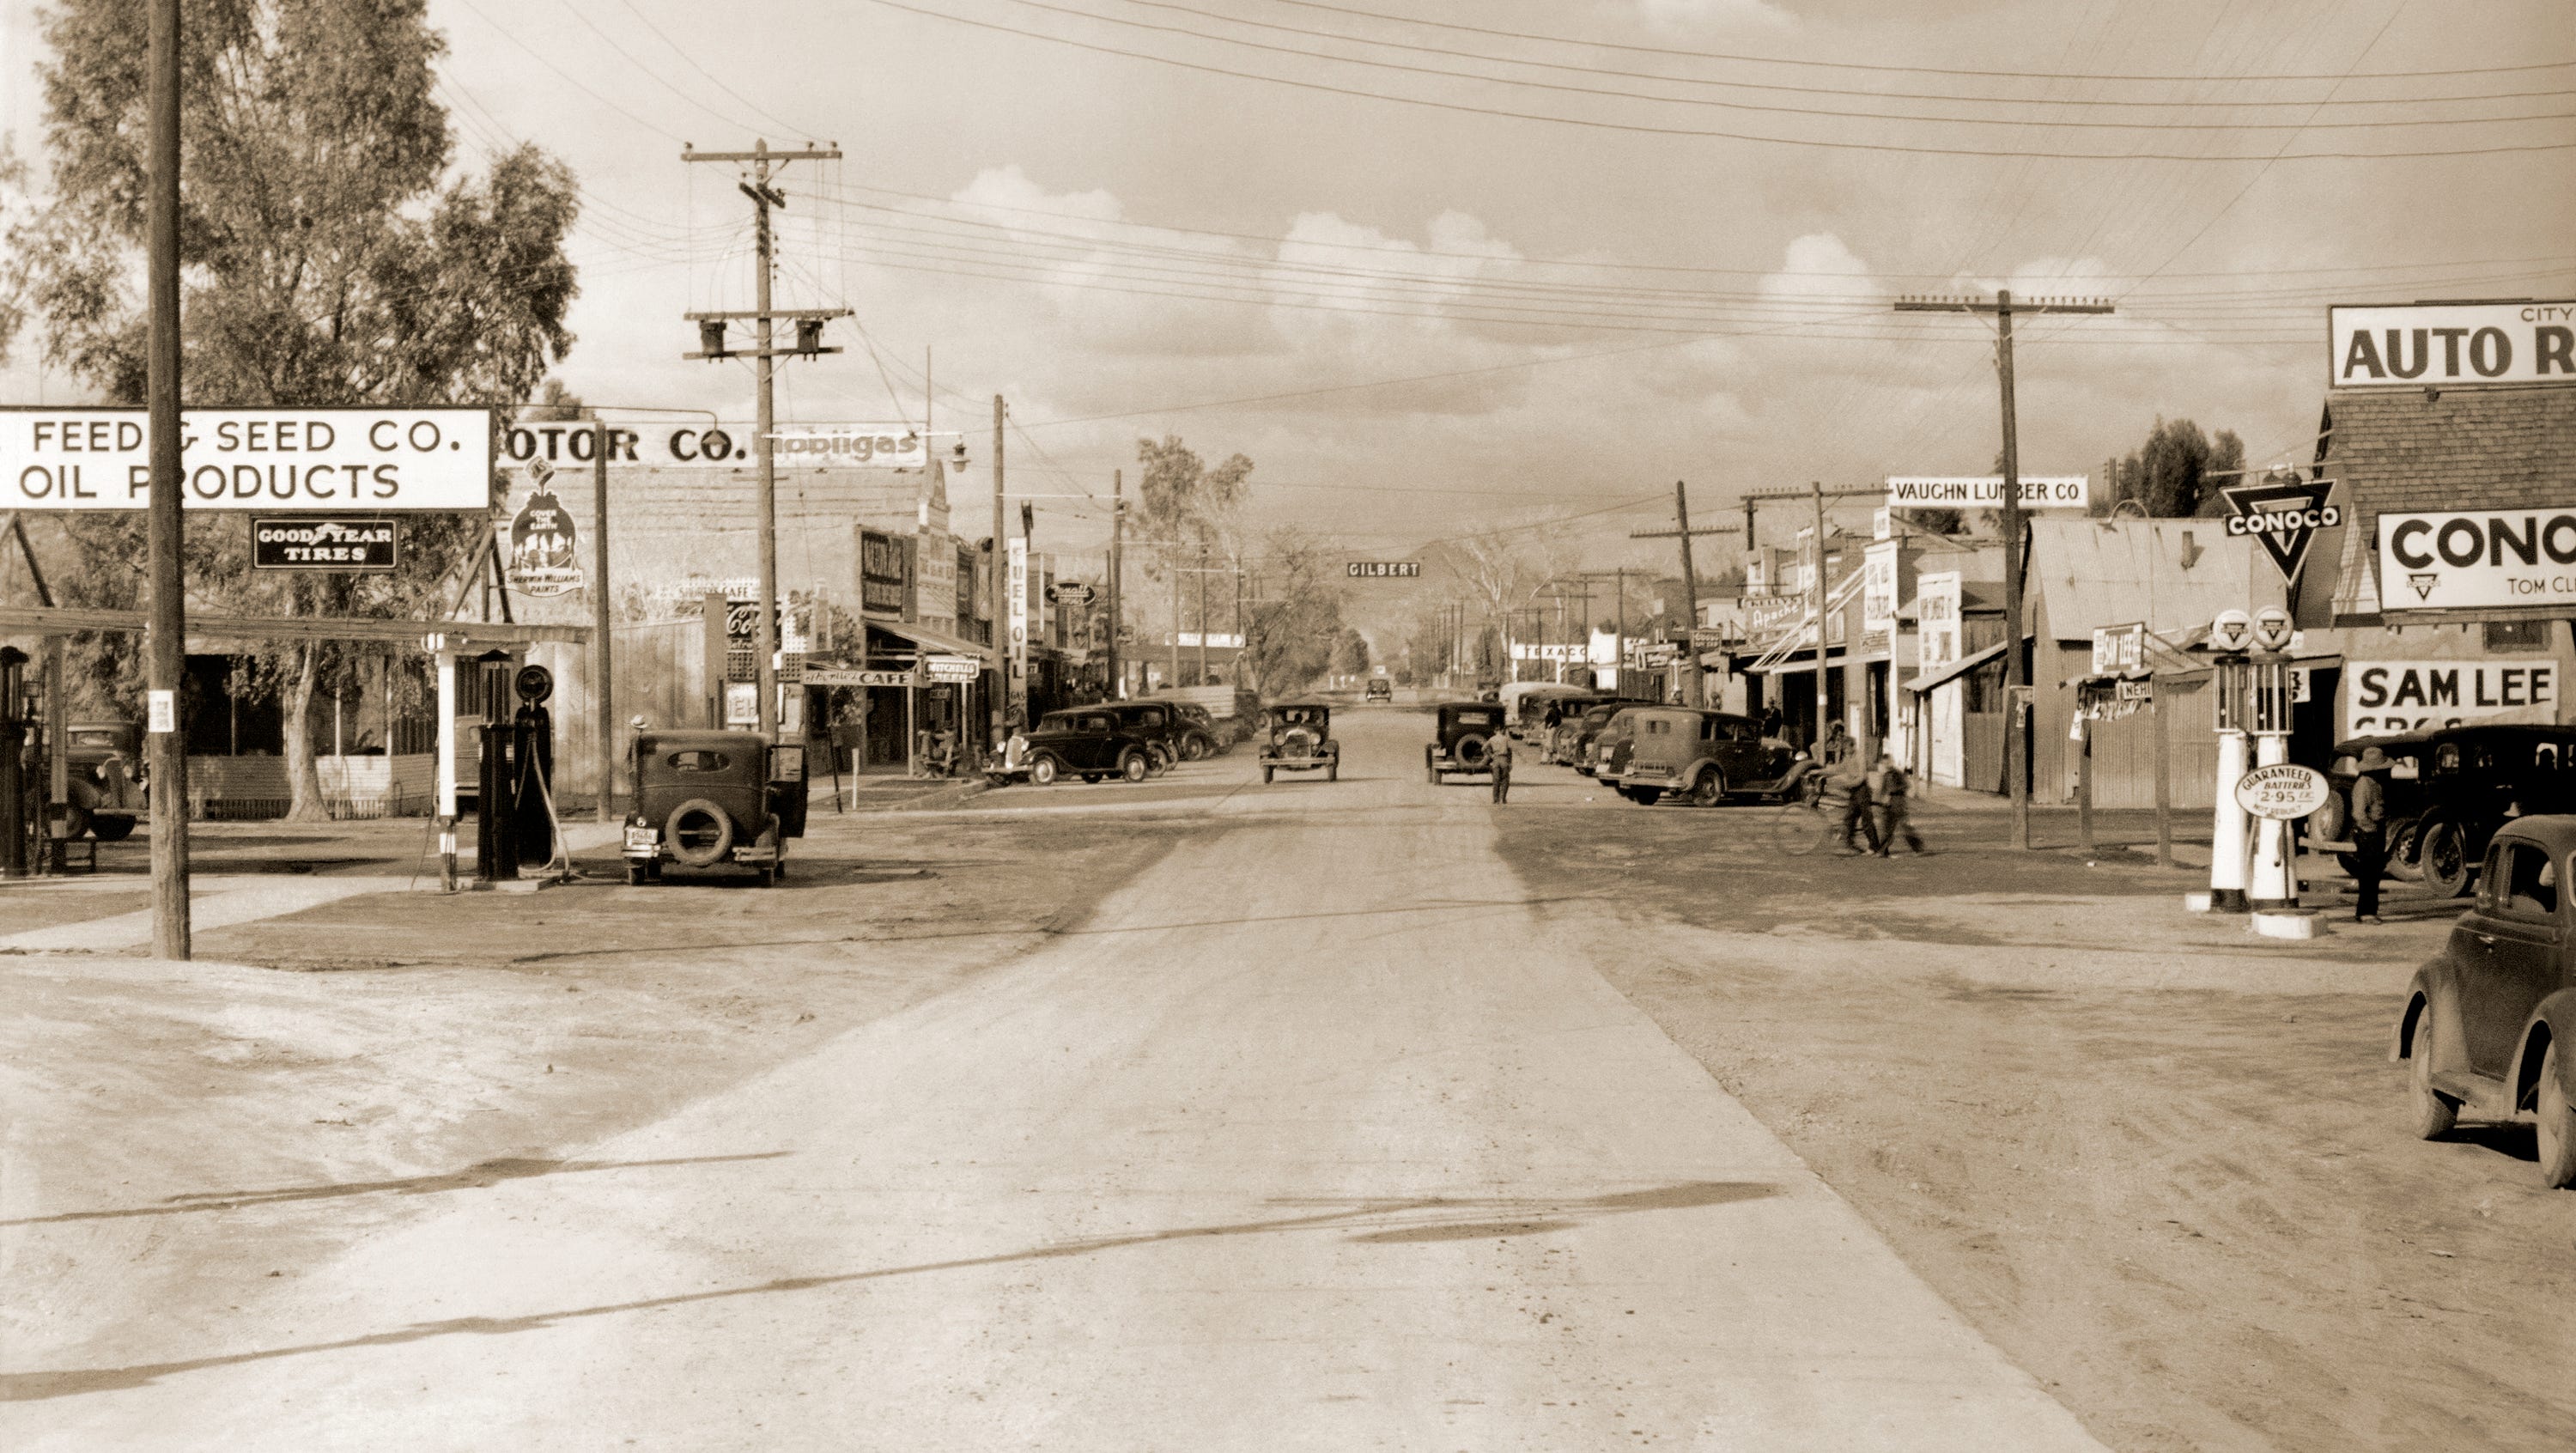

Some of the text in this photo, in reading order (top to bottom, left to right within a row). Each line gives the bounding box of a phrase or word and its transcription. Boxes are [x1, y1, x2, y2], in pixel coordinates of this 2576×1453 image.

[2520, 307, 2574, 322] CITY
[2343, 325, 2576, 379] AUTO R
[33, 422, 143, 452] FEED
[217, 421, 335, 452] SEED
[369, 420, 460, 453] CO.
[670, 429, 746, 460] CO.
[20, 464, 400, 500] OIL PODUCTS
[1896, 483, 1967, 500] VAUGHN
[2228, 507, 2339, 535] CONOCO
[2391, 514, 2576, 569] CONO
[284, 547, 367, 561] TIRES
[1349, 562, 1419, 576] GILBERT
[530, 586, 559, 594] PAINTS
[2507, 576, 2576, 594] TOM CL
[1012, 547, 1024, 679] FUEL OIL
[859, 673, 909, 684] CAFE
[2126, 683, 2151, 696] NEHI
[2359, 668, 2552, 708] SAM LEE
[2242, 768, 2312, 790] GUARANTEED
